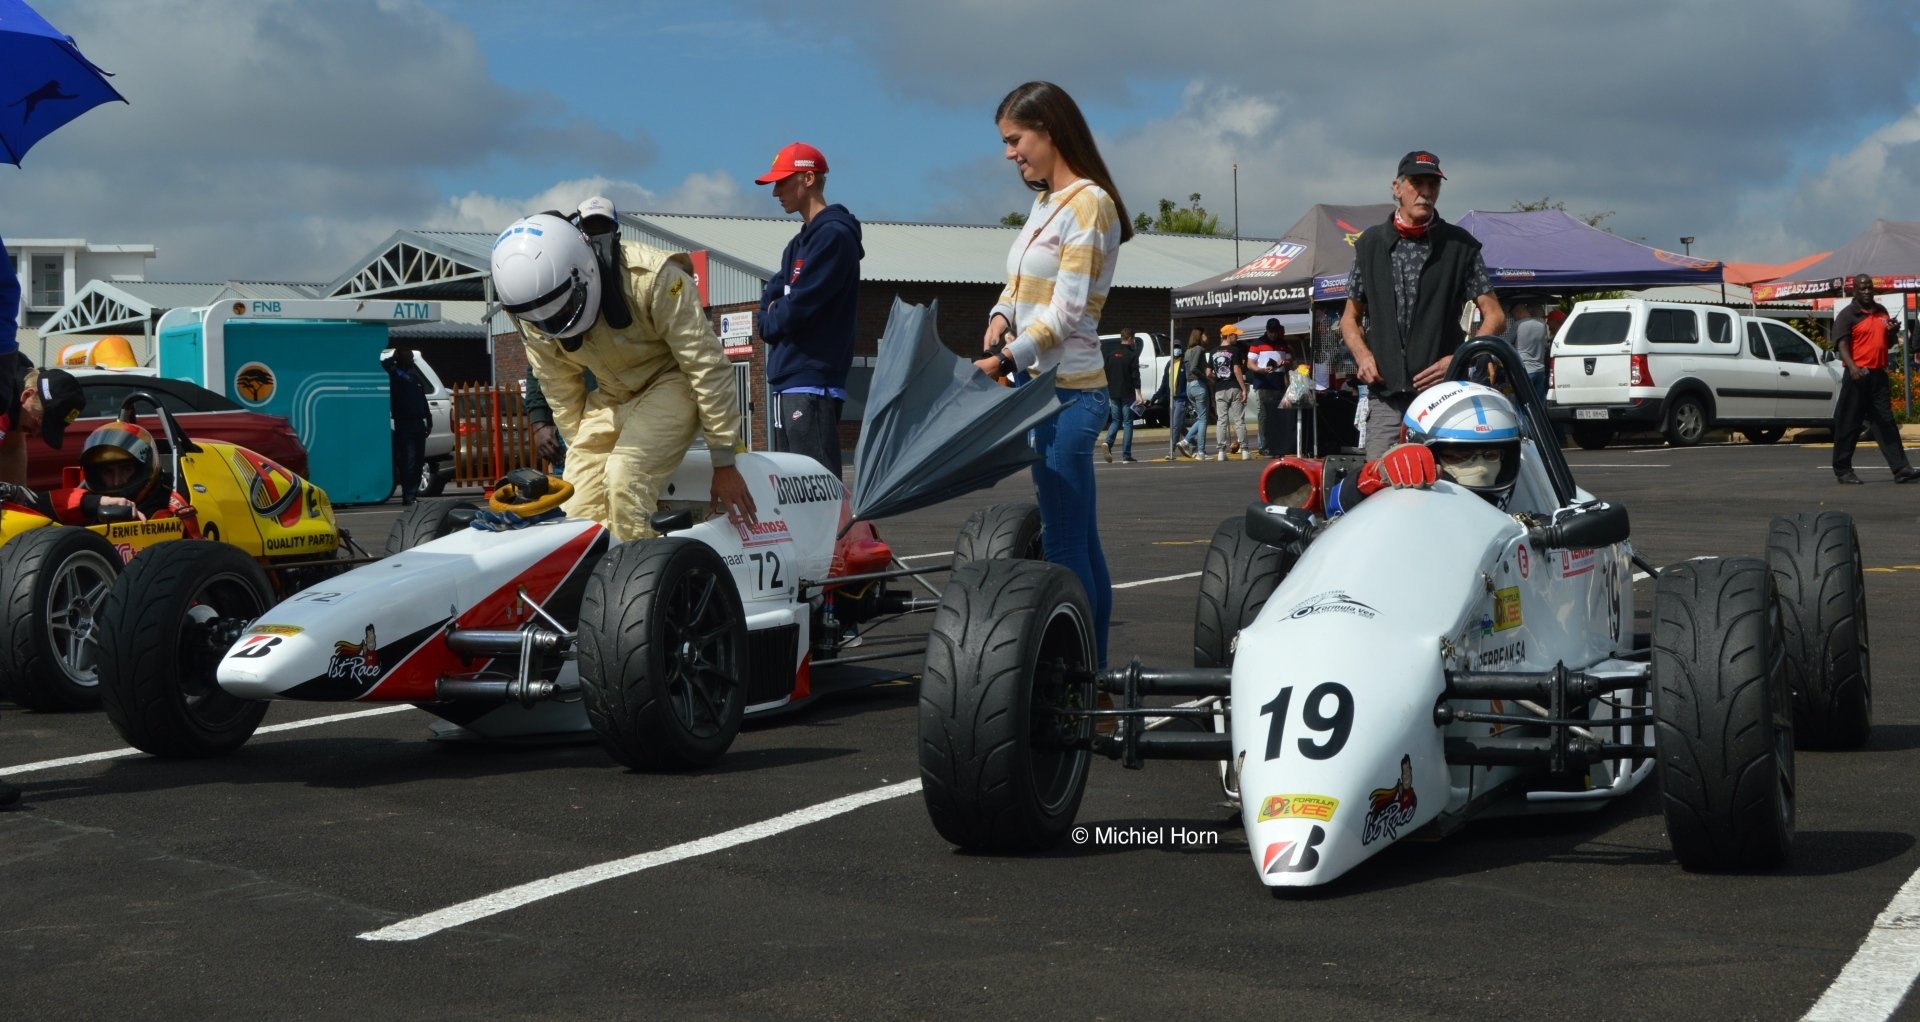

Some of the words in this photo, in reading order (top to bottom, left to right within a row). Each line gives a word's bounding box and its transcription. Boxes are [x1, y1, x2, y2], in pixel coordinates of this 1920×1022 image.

[1175, 286, 1306, 308] www.liqui-moly.co.za
[252, 300, 282, 313] FNB
[393, 302, 429, 319] ATM
[1427, 388, 1464, 412] Marlboro
[112, 526, 139, 538] ERNIE
[140, 521, 182, 535] VERMAAK
[266, 536, 306, 551] QUALITY
[307, 533, 336, 547] PARTS
[749, 550, 784, 591] 72
[294, 591, 342, 603] 72
[346, 656, 382, 686] Race
[1259, 682, 1355, 762] 19
[1291, 803, 1332, 818] VEE
[1293, 797, 1335, 807] FORMULA
[1383, 802, 1415, 840] Race
